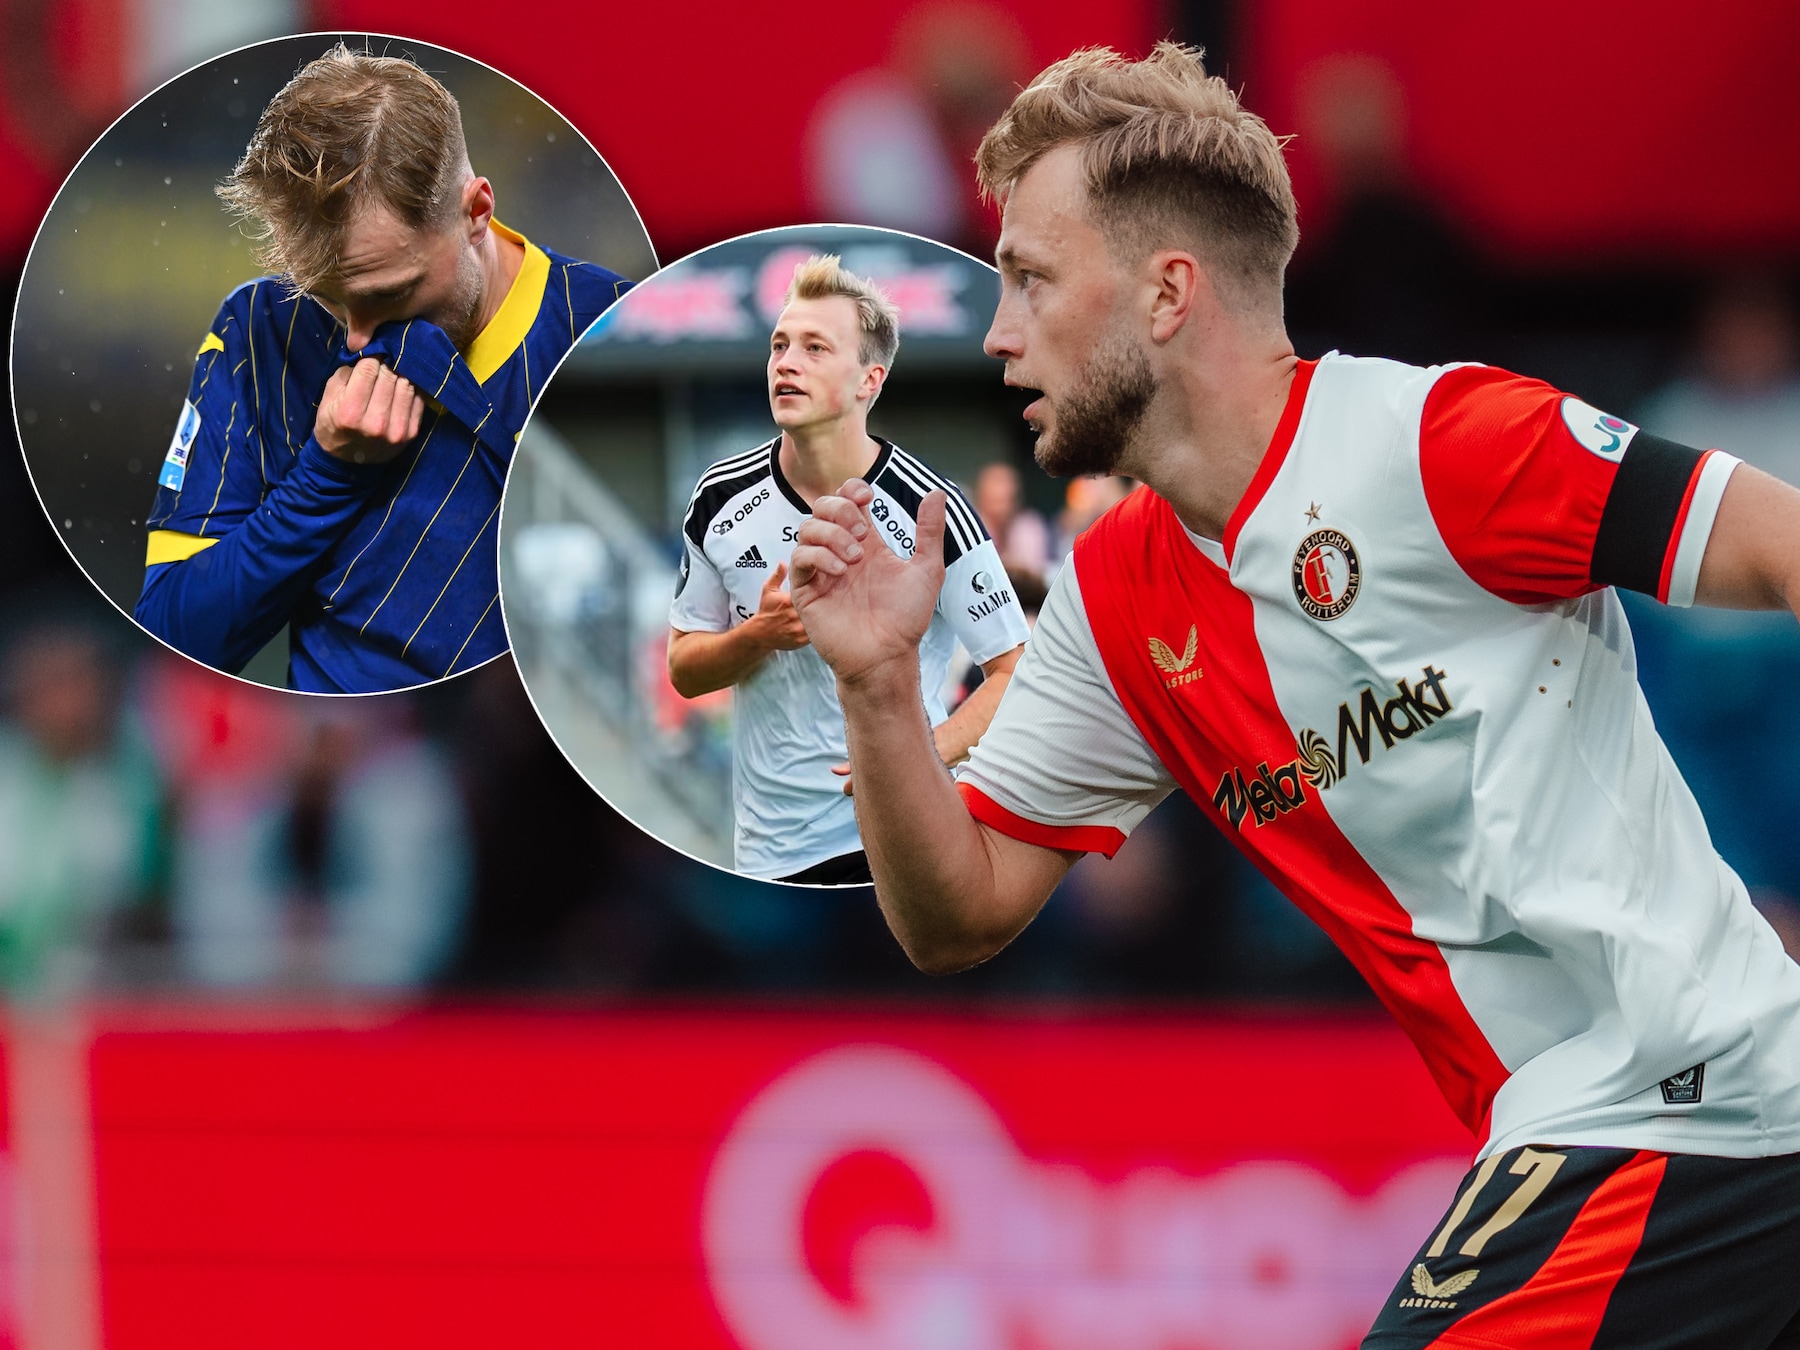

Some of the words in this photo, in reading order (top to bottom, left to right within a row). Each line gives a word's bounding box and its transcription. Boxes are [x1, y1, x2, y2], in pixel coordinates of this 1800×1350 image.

[734, 488, 770, 522] OBOS
[735, 560, 768, 569] adidas
[1294, 531, 1350, 574] FEYENOORD
[1300, 572, 1359, 618] ROTTERDAM
[1425, 1146, 1568, 1258] 17
[1398, 1297, 1458, 1309] CASTORE
